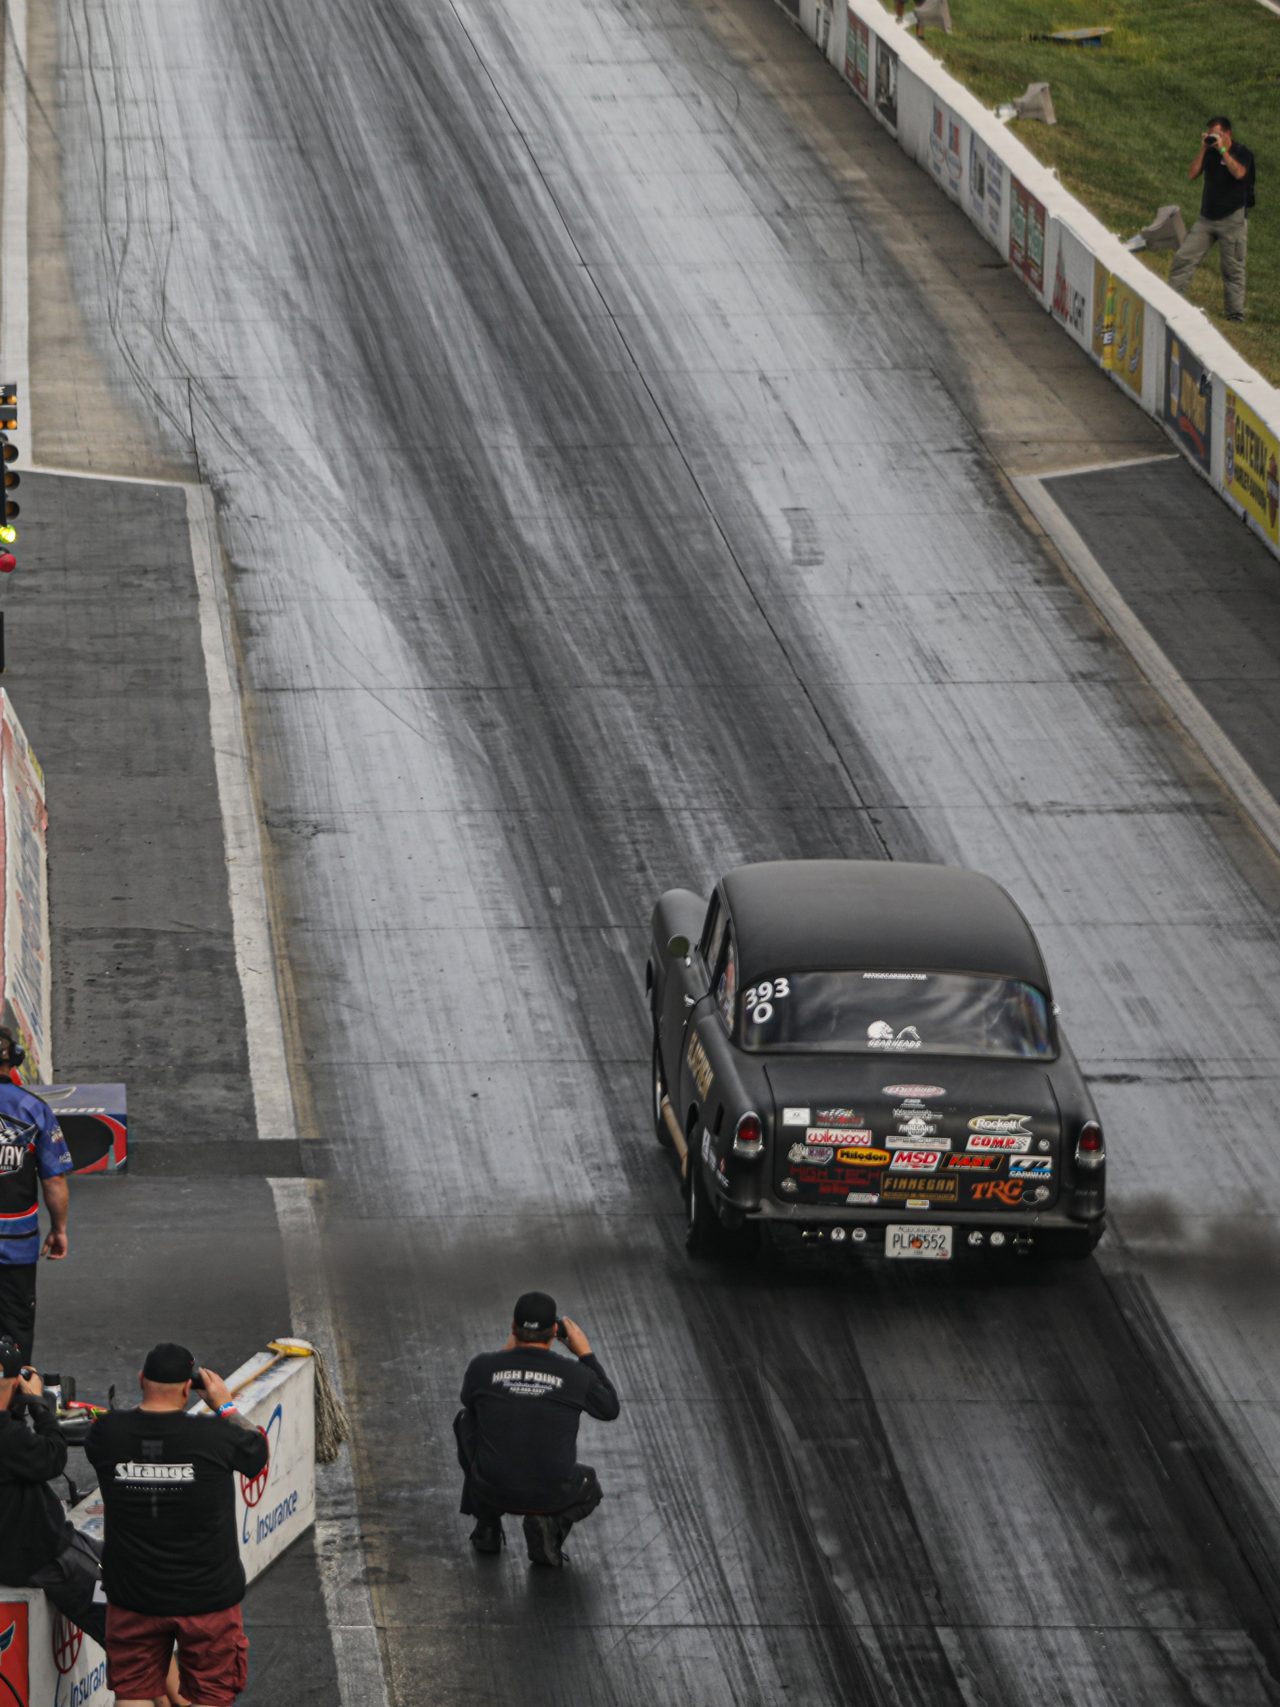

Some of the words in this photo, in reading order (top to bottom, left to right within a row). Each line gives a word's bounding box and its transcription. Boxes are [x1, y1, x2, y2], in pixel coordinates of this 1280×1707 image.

[745, 977, 790, 1010] 393
[976, 1119, 1017, 1129] Rockett
[808, 1129, 871, 1144] wilwood
[970, 1136, 1016, 1147] COMP
[840, 1151, 888, 1161] Milodon
[894, 1152, 938, 1164] MSD
[949, 1157, 994, 1167] FAST
[884, 1178, 956, 1191] FINNEGAN
[971, 1179, 1025, 1205] TRG
[492, 1370, 522, 1384] HIGH
[524, 1371, 563, 1388] POINT
[115, 1461, 194, 1480] Strange
[256, 1491, 297, 1544] Insurance
[71, 1661, 105, 1707] Insuran
